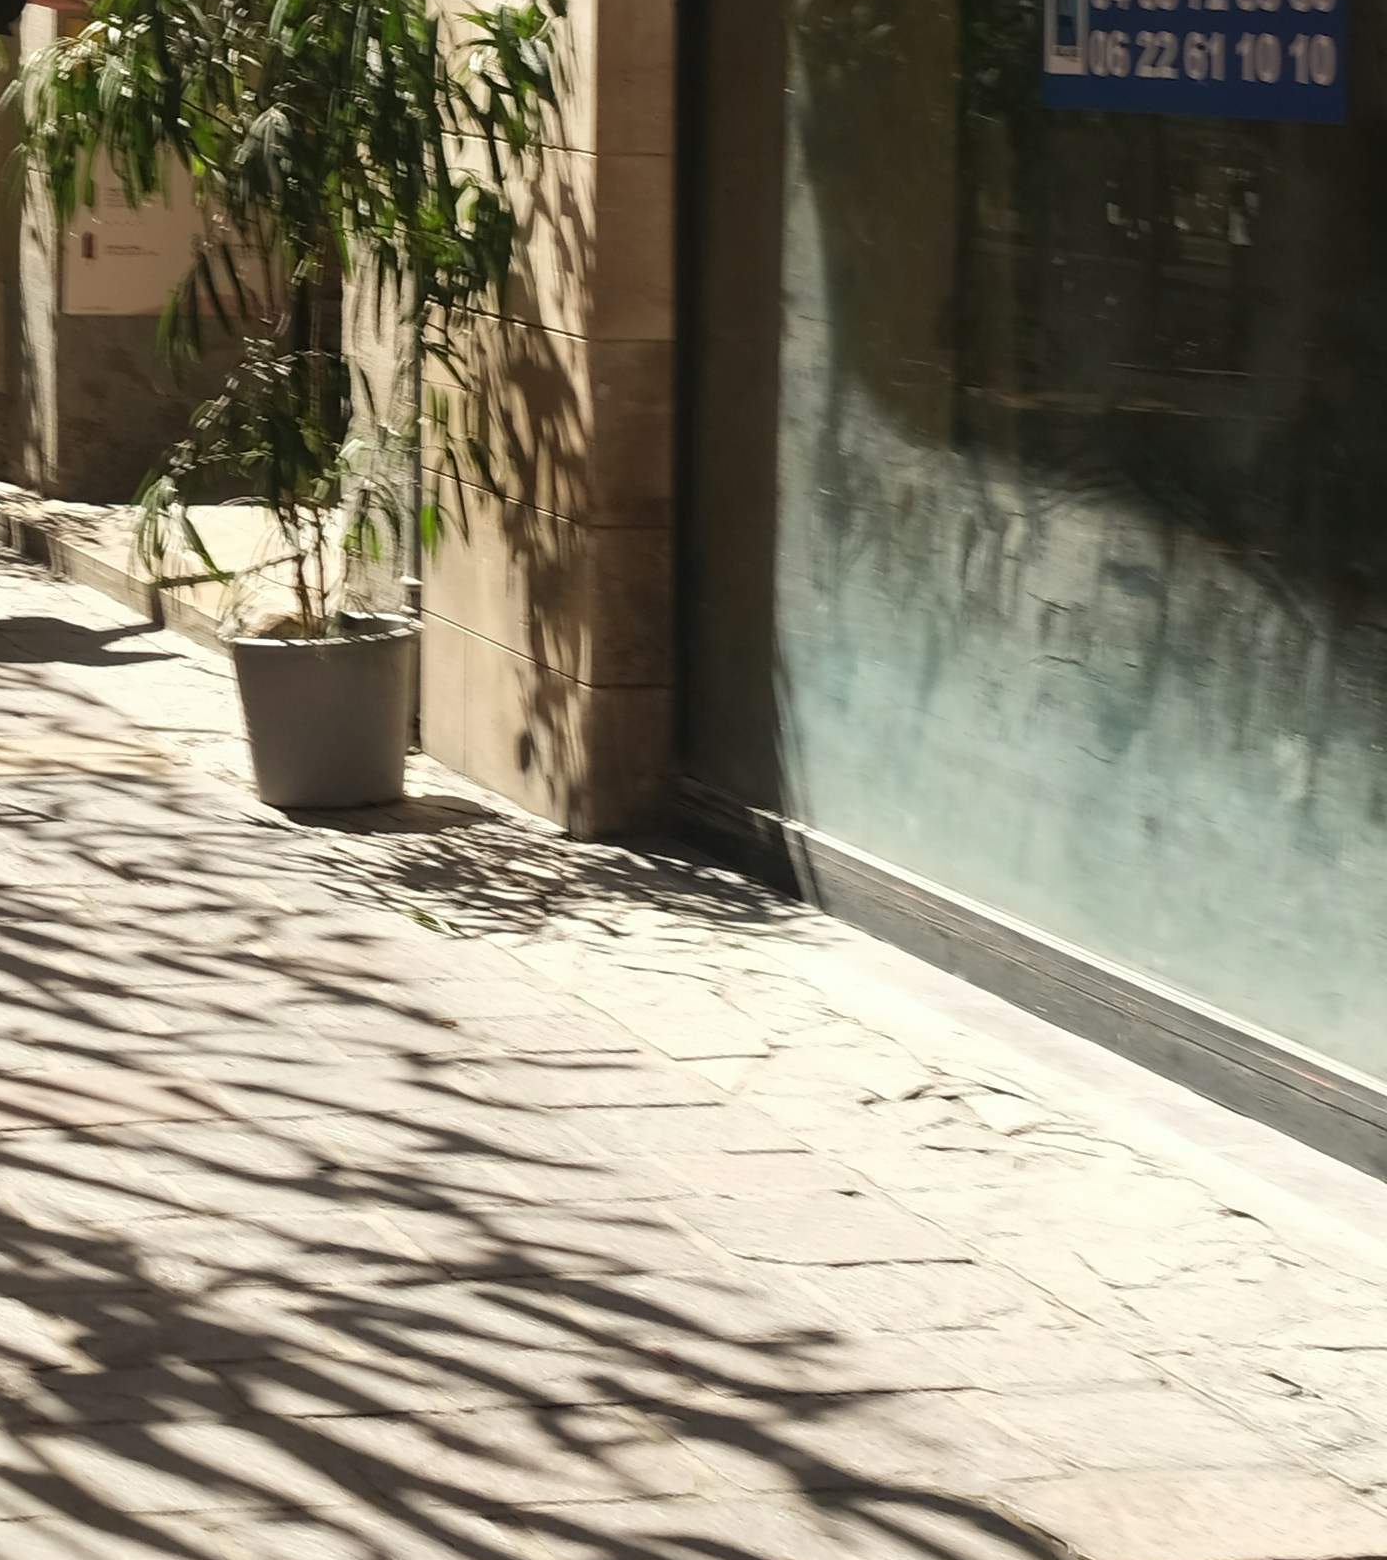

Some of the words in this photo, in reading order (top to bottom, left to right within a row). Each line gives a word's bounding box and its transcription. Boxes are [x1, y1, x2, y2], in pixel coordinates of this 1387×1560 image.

[1088, 28, 1132, 79] 06
[1134, 29, 1181, 80] 22
[1183, 30, 1227, 82] 61
[1235, 31, 1283, 84] 10
[1287, 32, 1338, 87] 10
